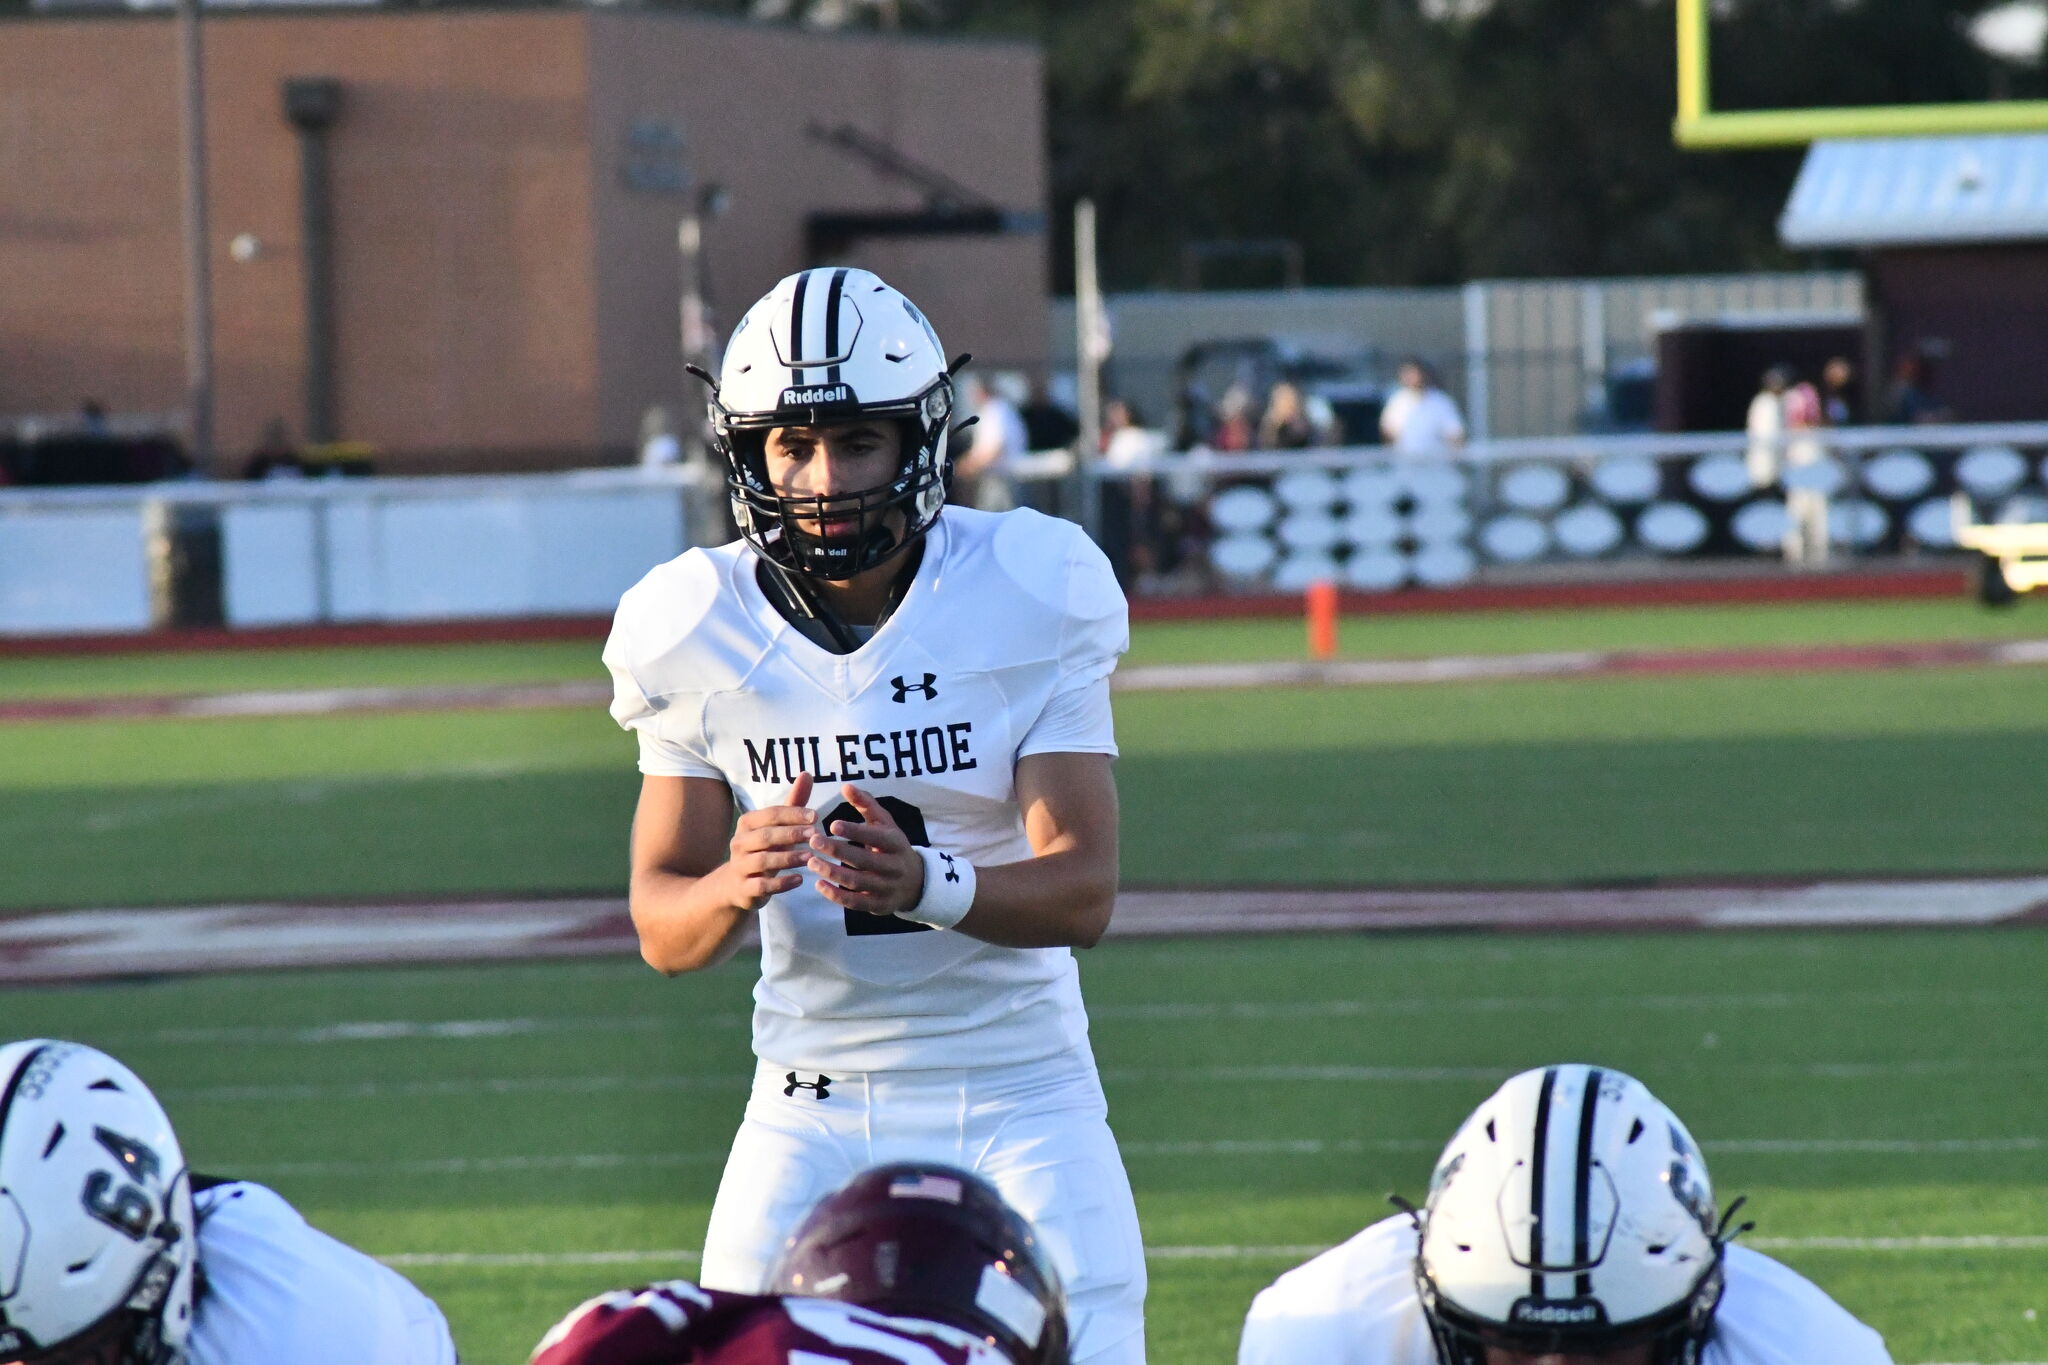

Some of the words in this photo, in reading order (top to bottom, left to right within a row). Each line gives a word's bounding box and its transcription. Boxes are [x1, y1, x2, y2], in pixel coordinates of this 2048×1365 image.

[783, 386, 847, 405] Riddell
[744, 722, 977, 784] MULESHOE
[81, 1123, 161, 1242] 64
